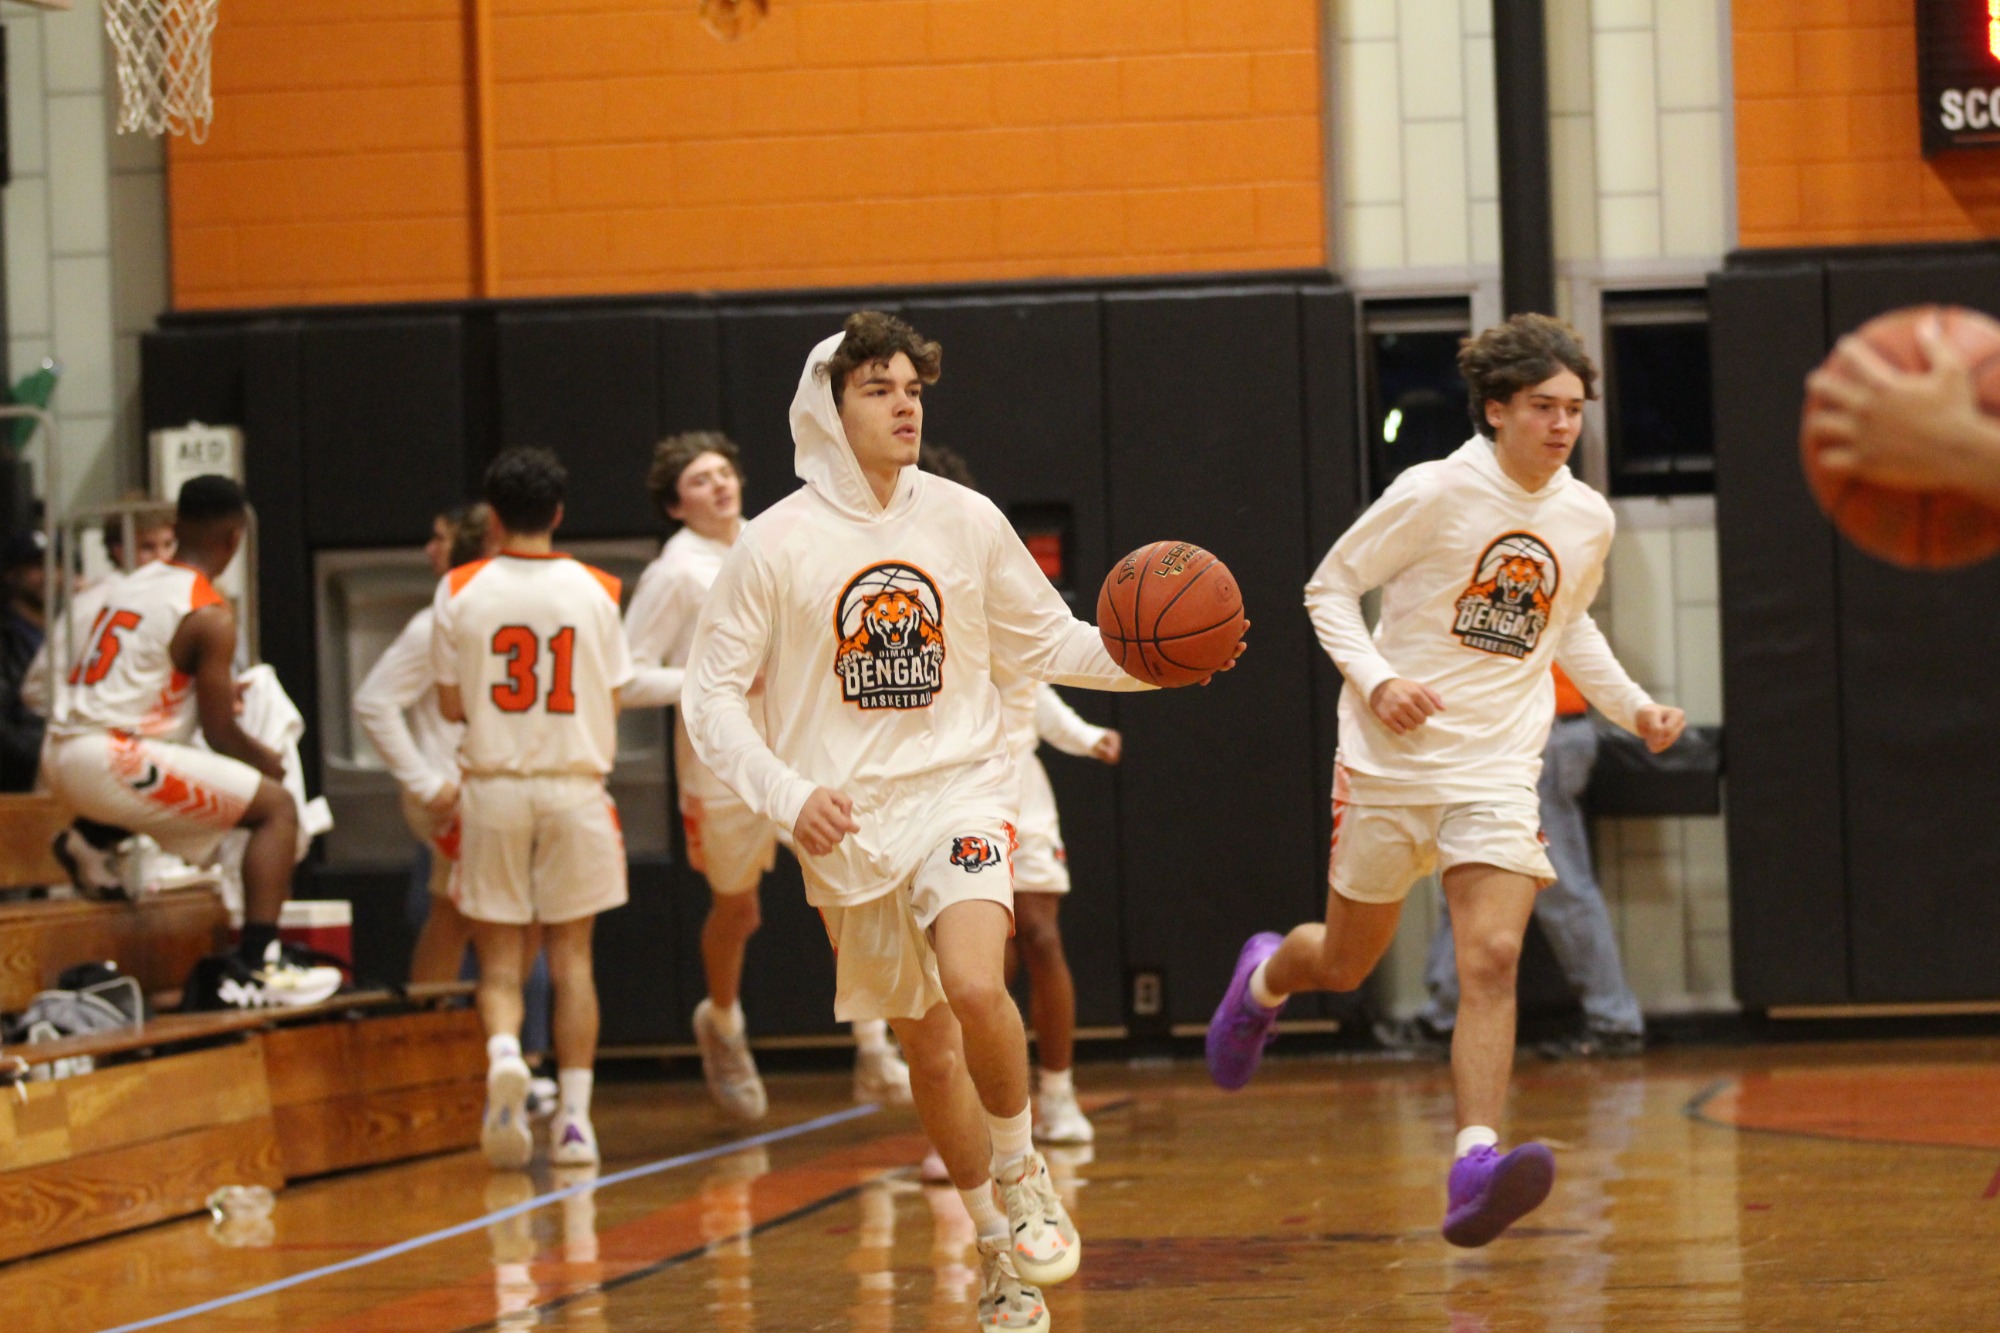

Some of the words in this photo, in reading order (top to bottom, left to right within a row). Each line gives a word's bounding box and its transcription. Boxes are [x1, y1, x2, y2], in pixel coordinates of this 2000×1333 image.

[1454, 602, 1542, 648] BENGALS
[490, 624, 576, 714] 31
[844, 652, 941, 697] BENGALS
[878, 647, 915, 658] DIMAN
